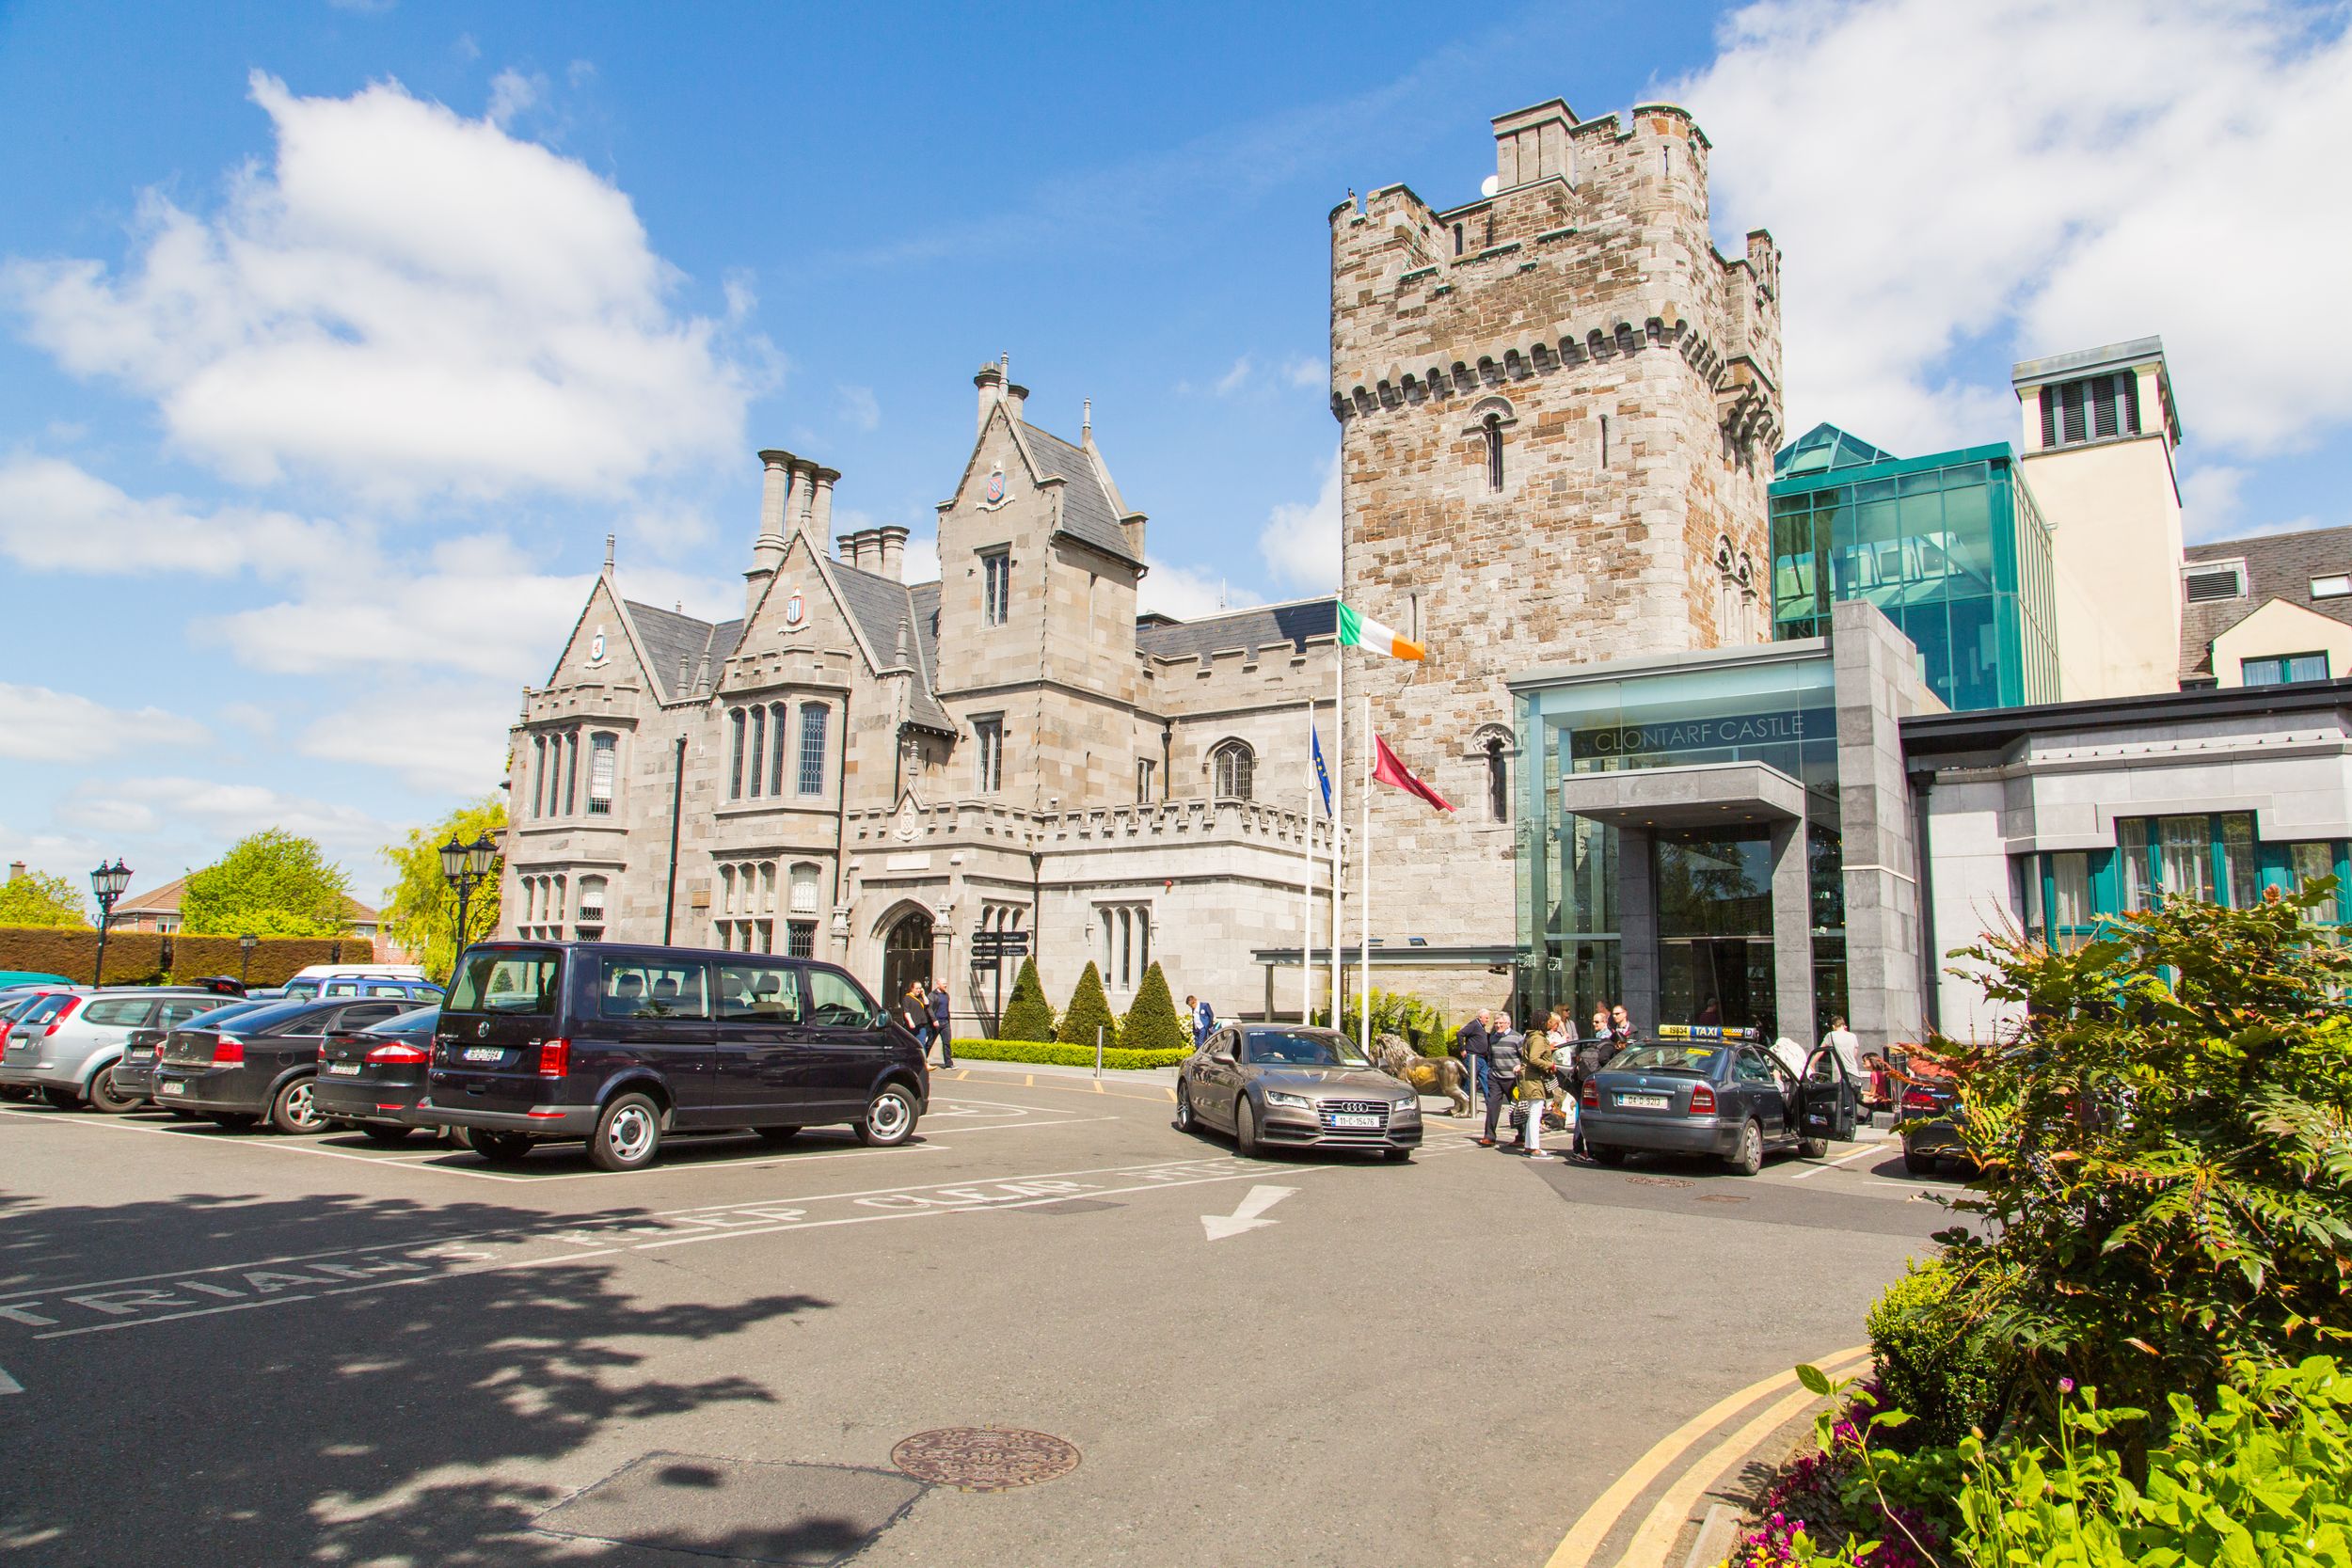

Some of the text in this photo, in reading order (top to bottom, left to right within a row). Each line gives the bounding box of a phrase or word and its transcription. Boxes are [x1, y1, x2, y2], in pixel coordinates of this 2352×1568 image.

[1595, 715, 1804, 752] CLONTARF CASTLE
[1694, 1026, 1718, 1037] TAXI
[853, 1180, 1107, 1210] CLEAR
